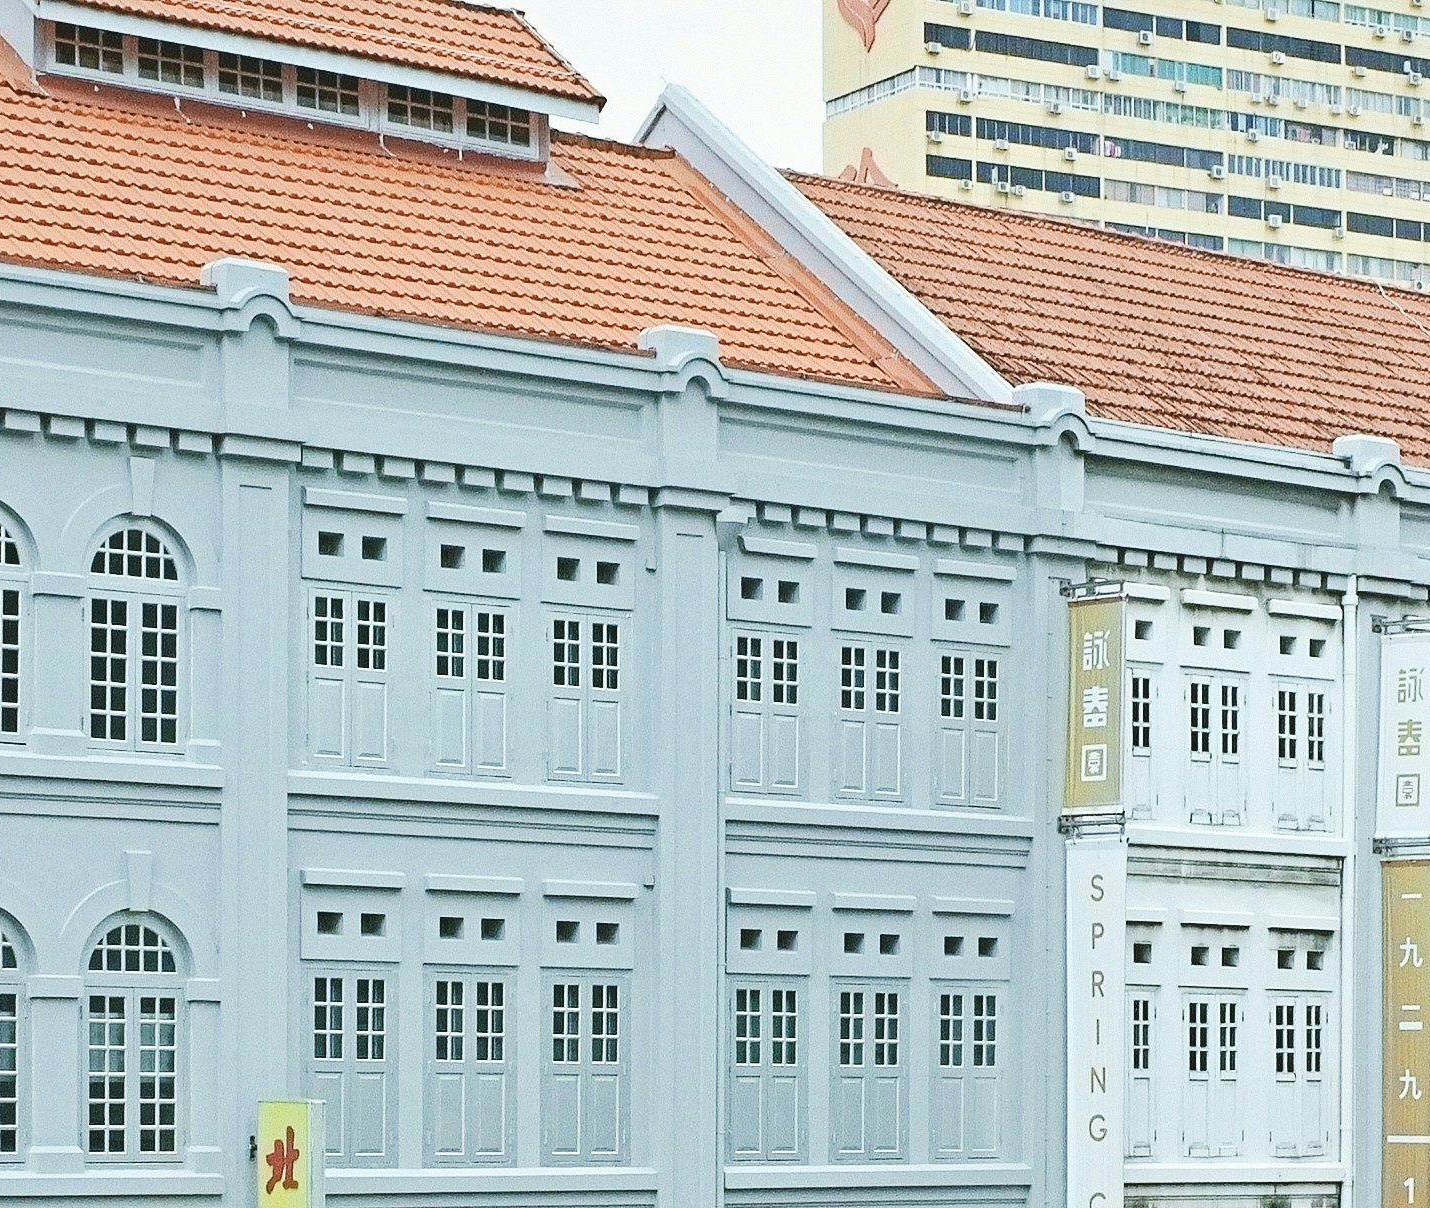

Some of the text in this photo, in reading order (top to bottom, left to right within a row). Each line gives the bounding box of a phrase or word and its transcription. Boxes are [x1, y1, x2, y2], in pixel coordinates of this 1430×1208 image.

[1087, 873, 1109, 1143] SPRING
[1398, 893, 1424, 1101] 一九二九
